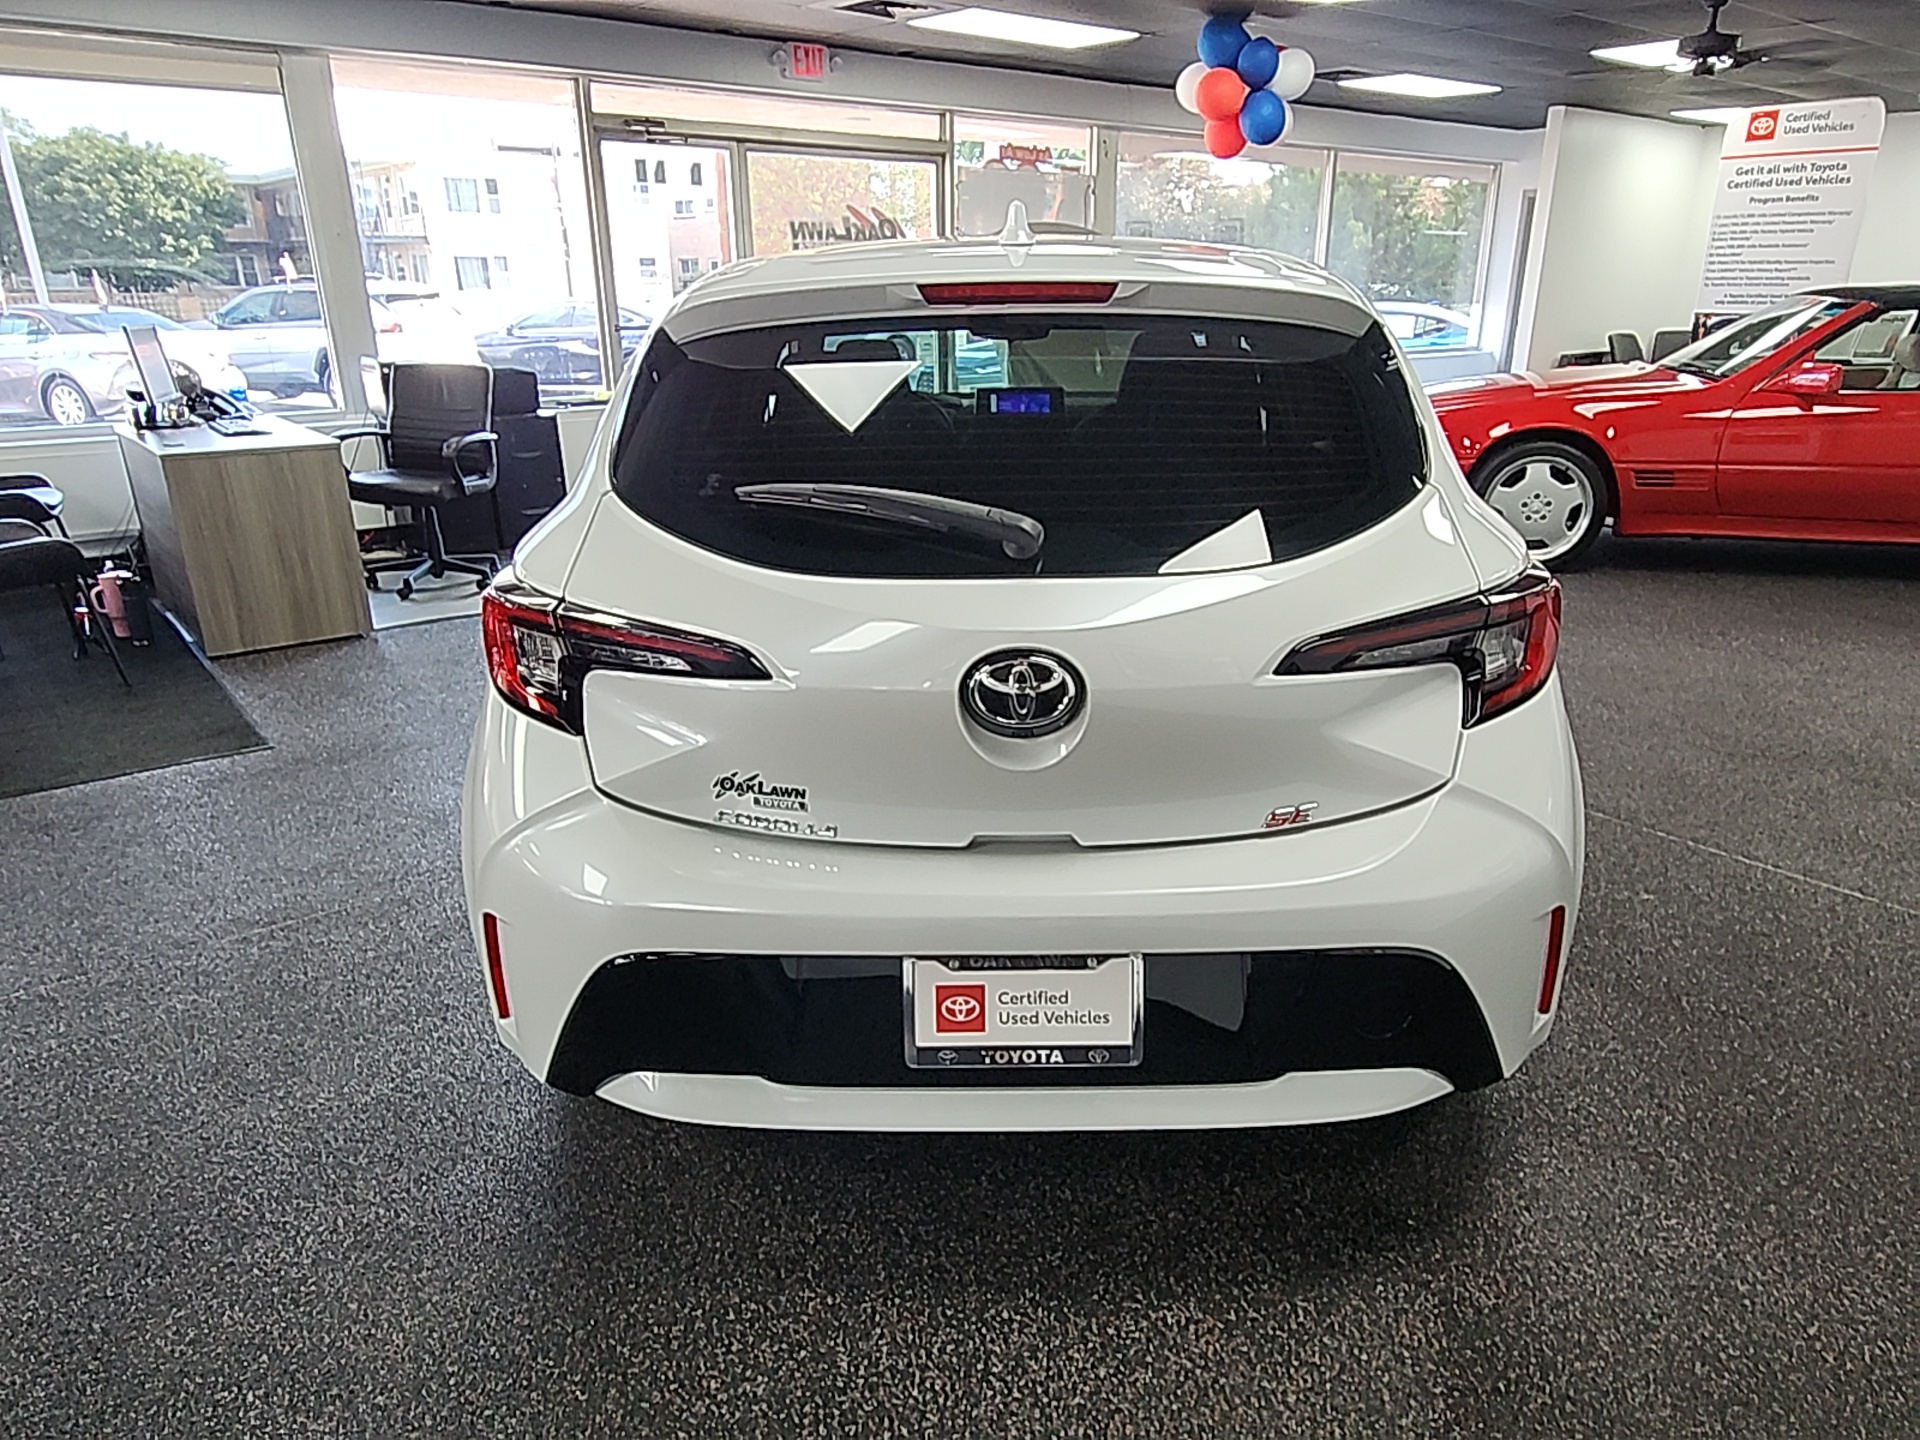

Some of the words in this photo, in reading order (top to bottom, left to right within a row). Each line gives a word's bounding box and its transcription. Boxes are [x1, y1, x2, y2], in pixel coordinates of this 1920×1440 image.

[793, 44, 825, 76] EXIT
[1785, 110, 1832, 123] Certified
[1783, 124, 1811, 135] Used
[1811, 121, 1855, 134] Vehicles
[1735, 166, 1756, 177] Get
[1756, 165, 1766, 176] it
[1767, 164, 1781, 176] all
[1783, 163, 1808, 174] with
[1810, 161, 1848, 174] Toyota
[1727, 177, 1773, 190] Certified
[1775, 175, 1803, 187] Used
[1805, 174, 1852, 186] Vehicles
[1749, 196, 1784, 206] Program
[1785, 194, 1820, 204] Benefits
[759, 798, 801, 811] TOYOTA
[1261, 801, 1319, 828] SE
[715, 811, 838, 838] COROLLA
[997, 990, 1069, 1006] Certified
[998, 1010, 1040, 1026] Used
[1044, 1009, 1111, 1026] Vehicles
[981, 1049, 1064, 1065] TOYOTA
